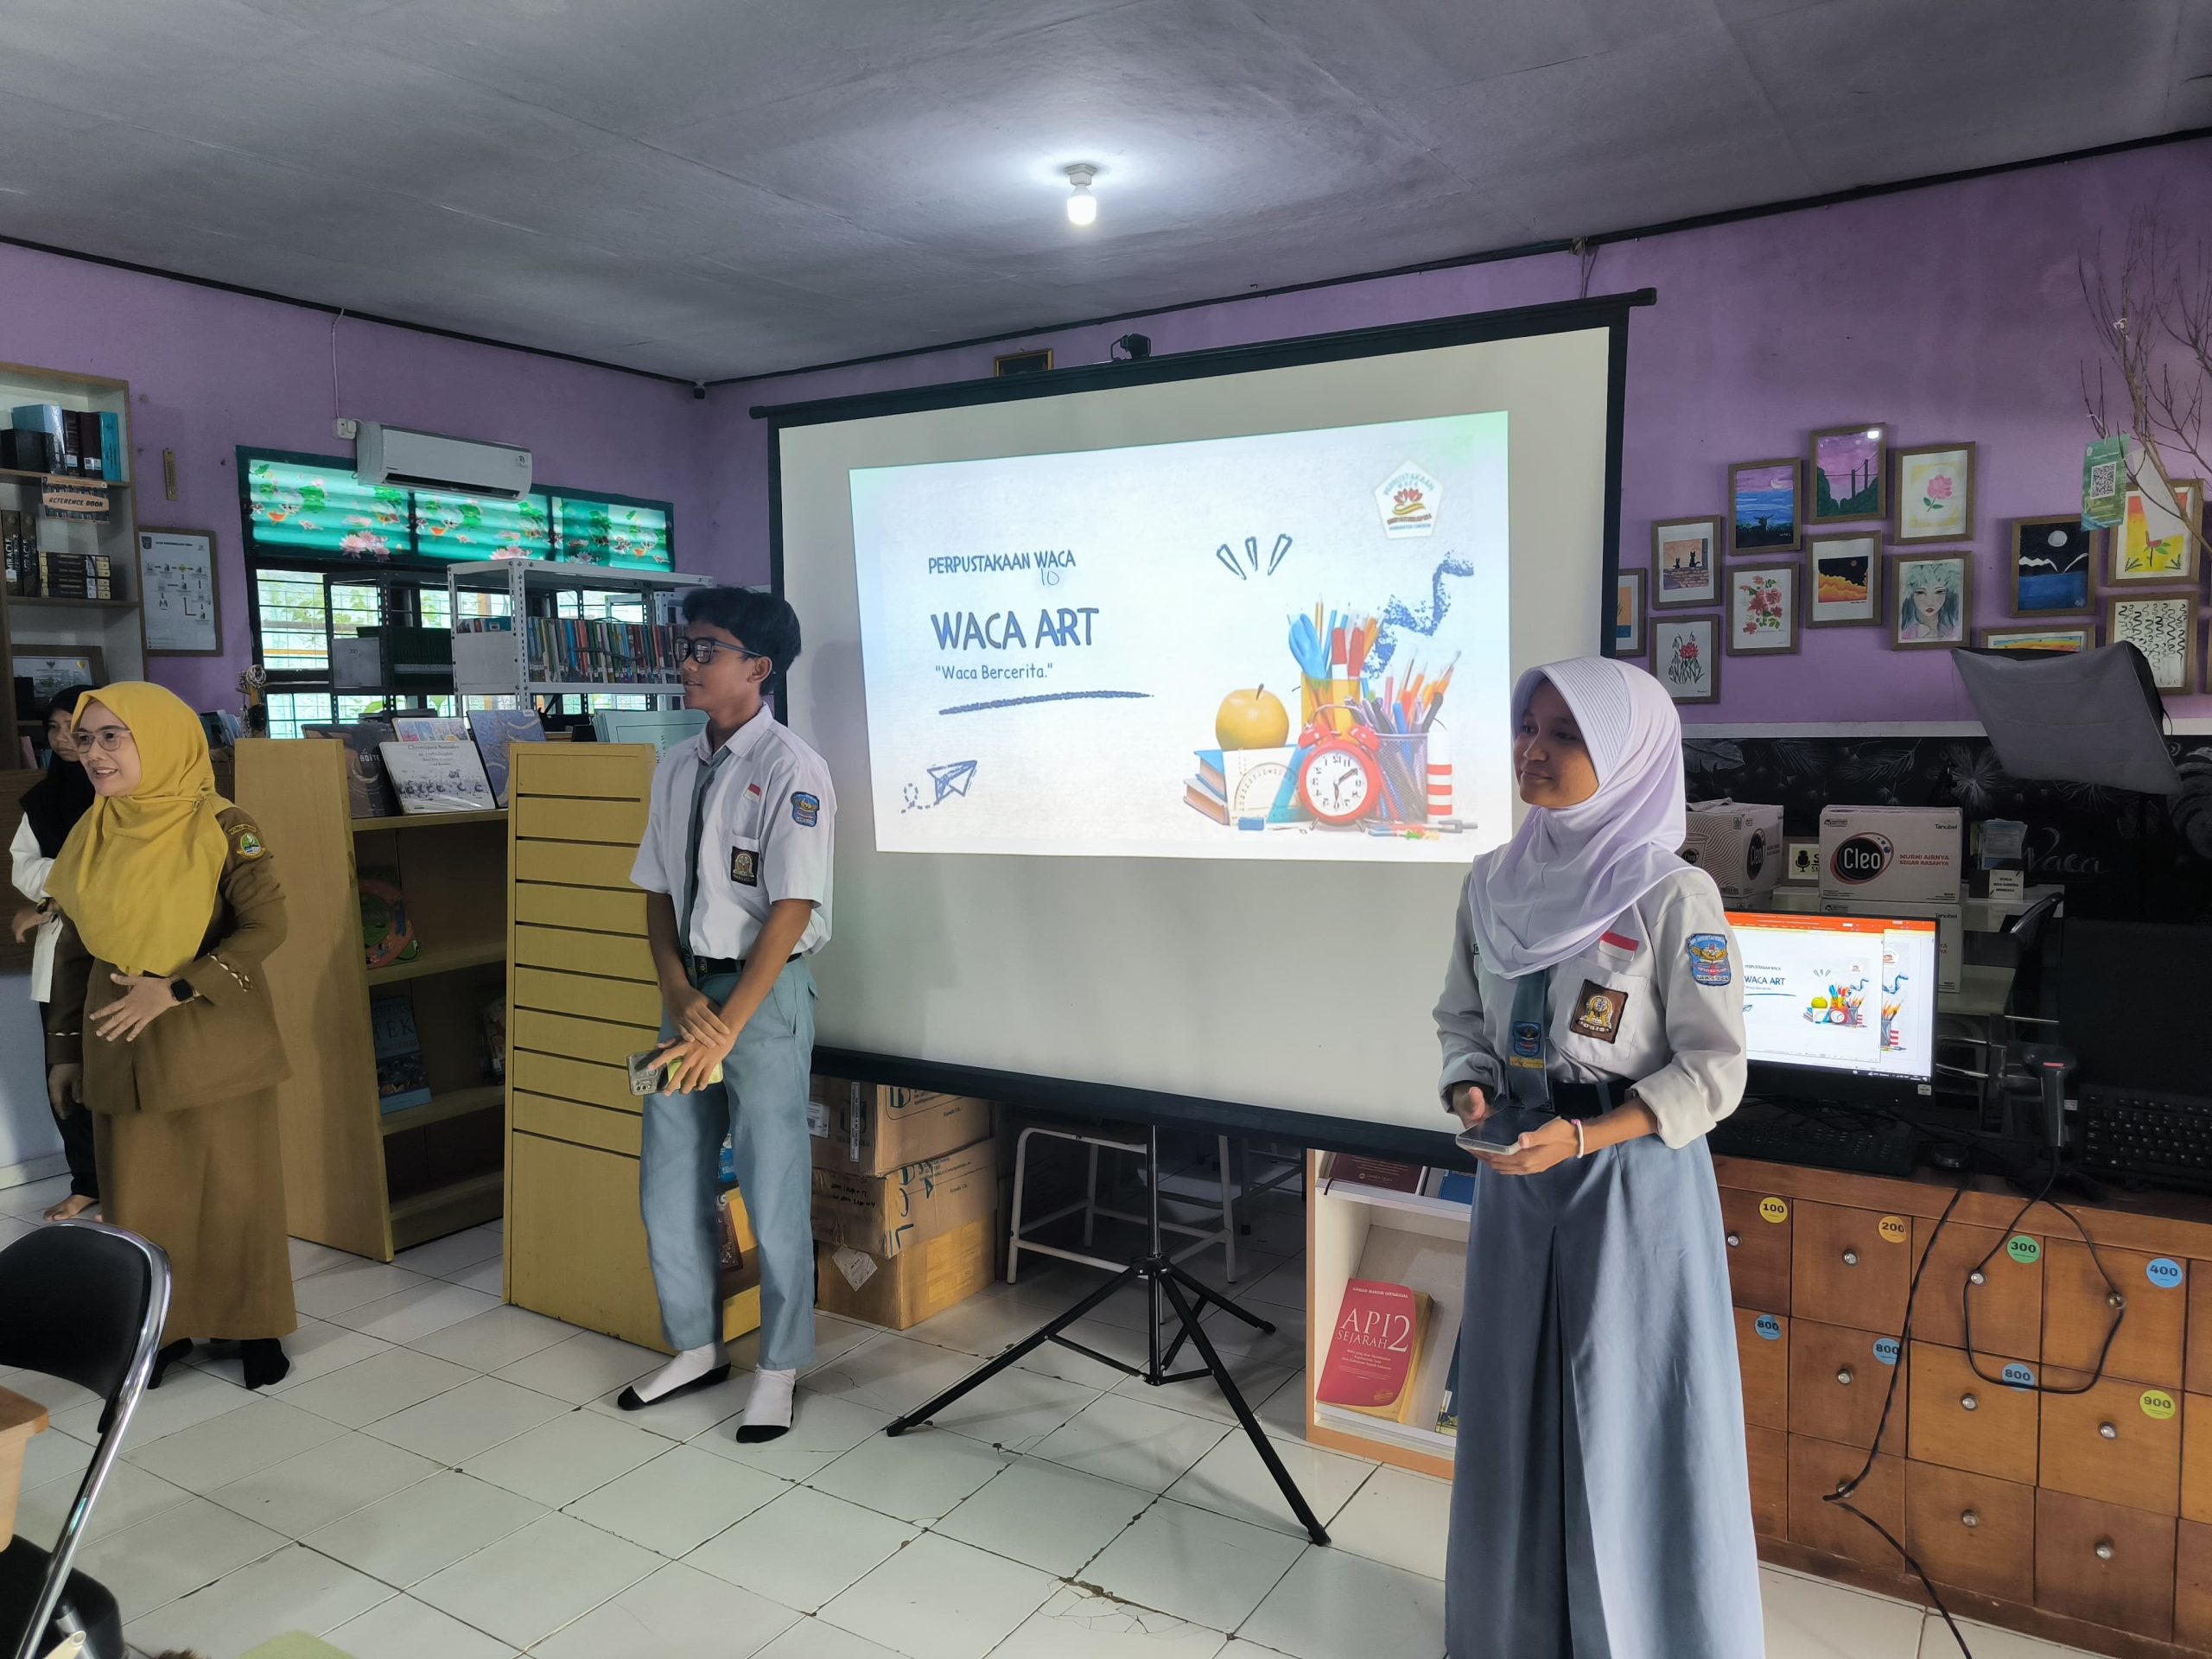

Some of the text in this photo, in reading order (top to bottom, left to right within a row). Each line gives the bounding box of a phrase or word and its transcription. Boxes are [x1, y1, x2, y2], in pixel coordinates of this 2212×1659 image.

[48, 497, 84, 506] REFERENCE
[928, 550, 1076, 574] PERPUSTAKAAN WACA
[931, 607, 1099, 651] WACA ART
[935, 663, 1053, 680] "Waca Bercerita."
[1843, 848, 1881, 869] Cleo
[1745, 976, 1786, 986] WACA ART
[1763, 1203, 1784, 1213] 100
[1881, 1222, 1904, 1233] 200
[2010, 1241, 2037, 1254] 300
[2150, 1264, 2178, 1277] 400
[1340, 1307, 1410, 1352] API 2
[1757, 1319, 1780, 1331] 800
[1337, 1330, 1389, 1350] SEJARAH
[1876, 1344, 1899, 1355] 800
[2004, 1369, 2031, 1381] 800
[2143, 1395, 2171, 1408] 900
